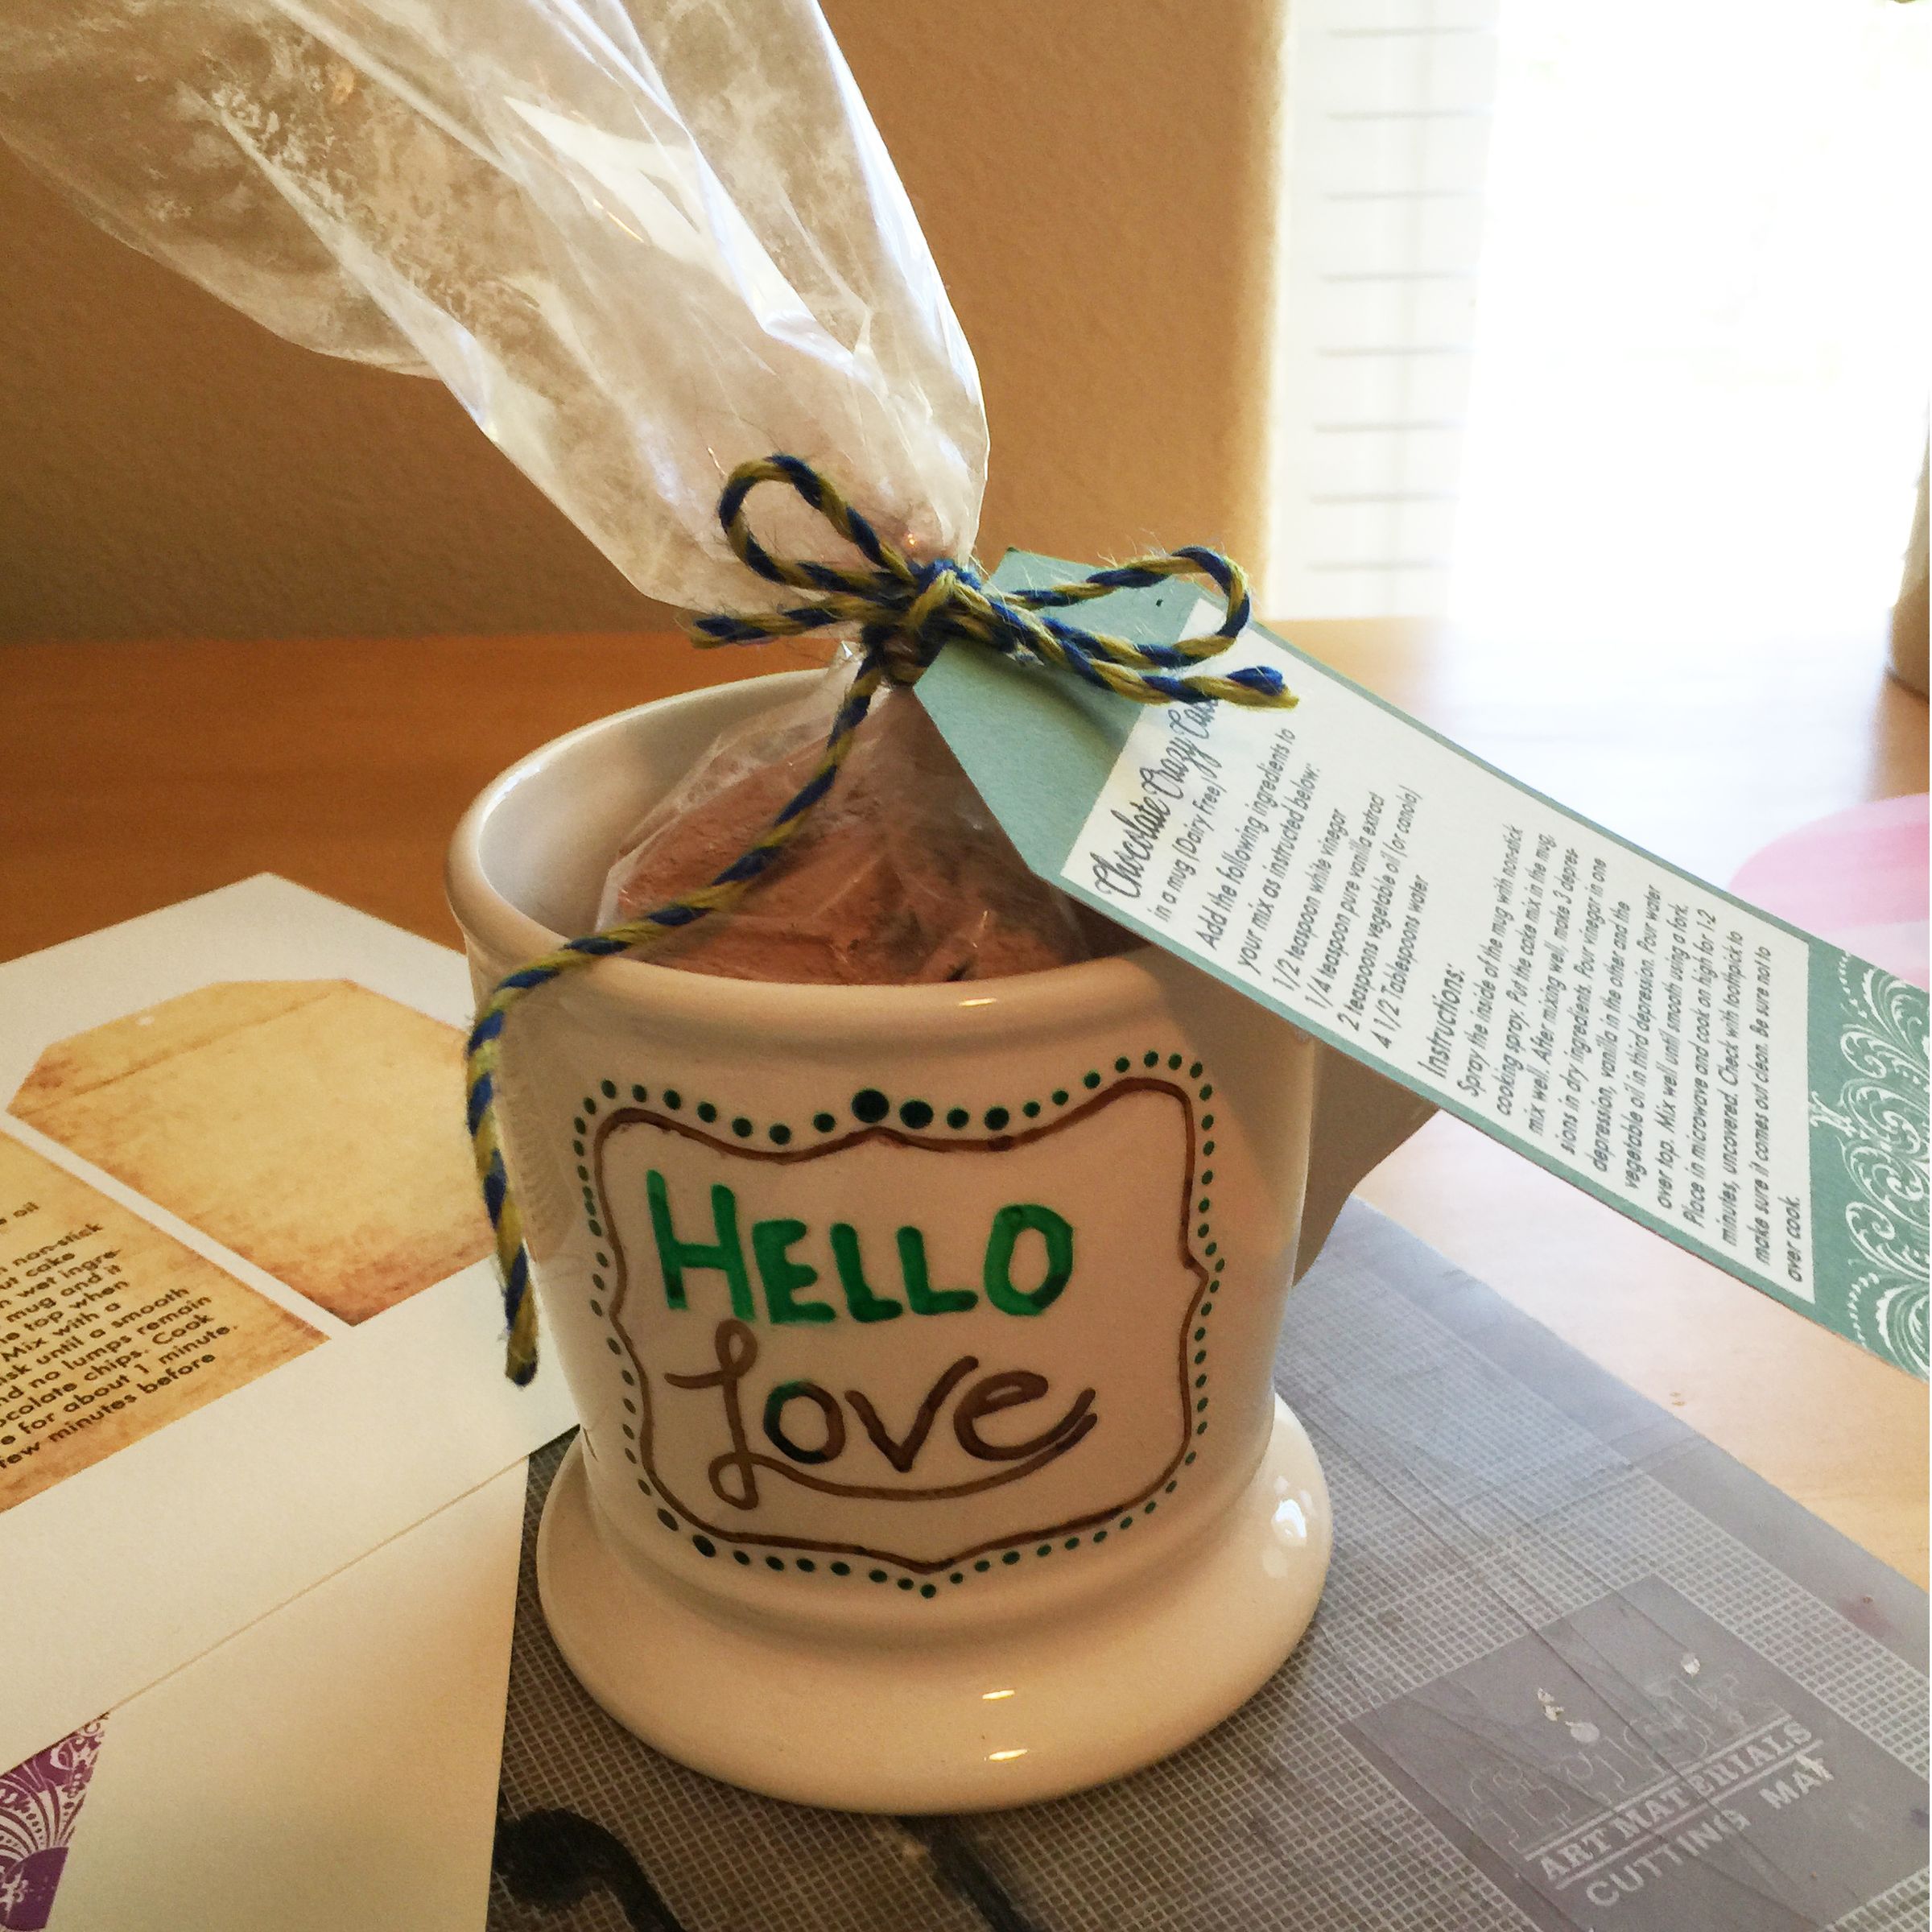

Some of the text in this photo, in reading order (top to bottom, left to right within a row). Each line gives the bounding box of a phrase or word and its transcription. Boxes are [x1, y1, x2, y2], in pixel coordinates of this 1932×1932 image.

[1089, 736, 1223, 899] Chocolate Crazy
[1146, 776, 1228, 923] in a mug (Dairy Free)
[1195, 728, 1296, 952] Add the following ingredients to
[1237, 762, 1321, 976] your mix as instructed below:
[1272, 807, 1349, 992] 1/2 teaspoon white vinegar
[1304, 791, 1385, 1009] 1/4 teaspoon pure vanilla extract
[1336, 785, 1423, 1032] 2 teaspoons vegetable oil (or canola)
[1370, 873, 1429, 1050] 4 1/2 Tablespoons water
[1456, 824, 1524, 1098] Spray the inside of the mug with non-stick
[1491, 832, 1558, 1117] cooking spray. Put the cake mix in the mug,
[1416, 963, 1466, 1080] Instructions:
[1523, 848, 1579, 1137] mix well. After mixing well, make 3 depres-
[1554, 857, 1607, 1156] sions in dry ingredients. Pour vinegar one
[1585, 901, 1631, 1173] depression, vanilla in the other and the
[1620, 884, 1662, 1190] vegetable oil in third depression. Pour water
[1653, 902, 1691, 1210] over top. Mix well until smooth using a fork.
[1681, 908, 1719, 1229] Place in microwave and cook on high for 1-2
[1715, 931, 1747, 1247] minutes, uncovered. Check with toothpick to
[1746, 946, 1772, 1266] make sure it comes out clean. Be sure not to
[6, 1272, 103, 1323] mug and
[12, 1223, 104, 1267] non-stick
[16, 1276, 57, 1298] wet
[24, 1280, 130, 1331] top when
[26, 1252, 76, 1278] cake
[647, 1170, 1074, 1323] HELLO
[1777, 1195, 1804, 1283] over cook.
[1, 1336, 47, 1362] Mix
[52, 1311, 101, 1336] with
[105, 1302, 121, 1312] a
[18, 1325, 239, 1435] for about 1 minute.
[28, 1296, 212, 1389] no lumps remain
[36, 1335, 85, 1365] until
[89, 1328, 106, 1339] a
[110, 1287, 190, 1328] smooth
[47, 1393, 138, 1443] minutes
[136, 1353, 217, 1394] before
[84, 1313, 216, 1381] chips. Cook
[663, 1319, 1098, 1510] Love
[1541, 1827, 1612, 1880] ART
[1586, 1810, 1751, 1907] CUTTING
